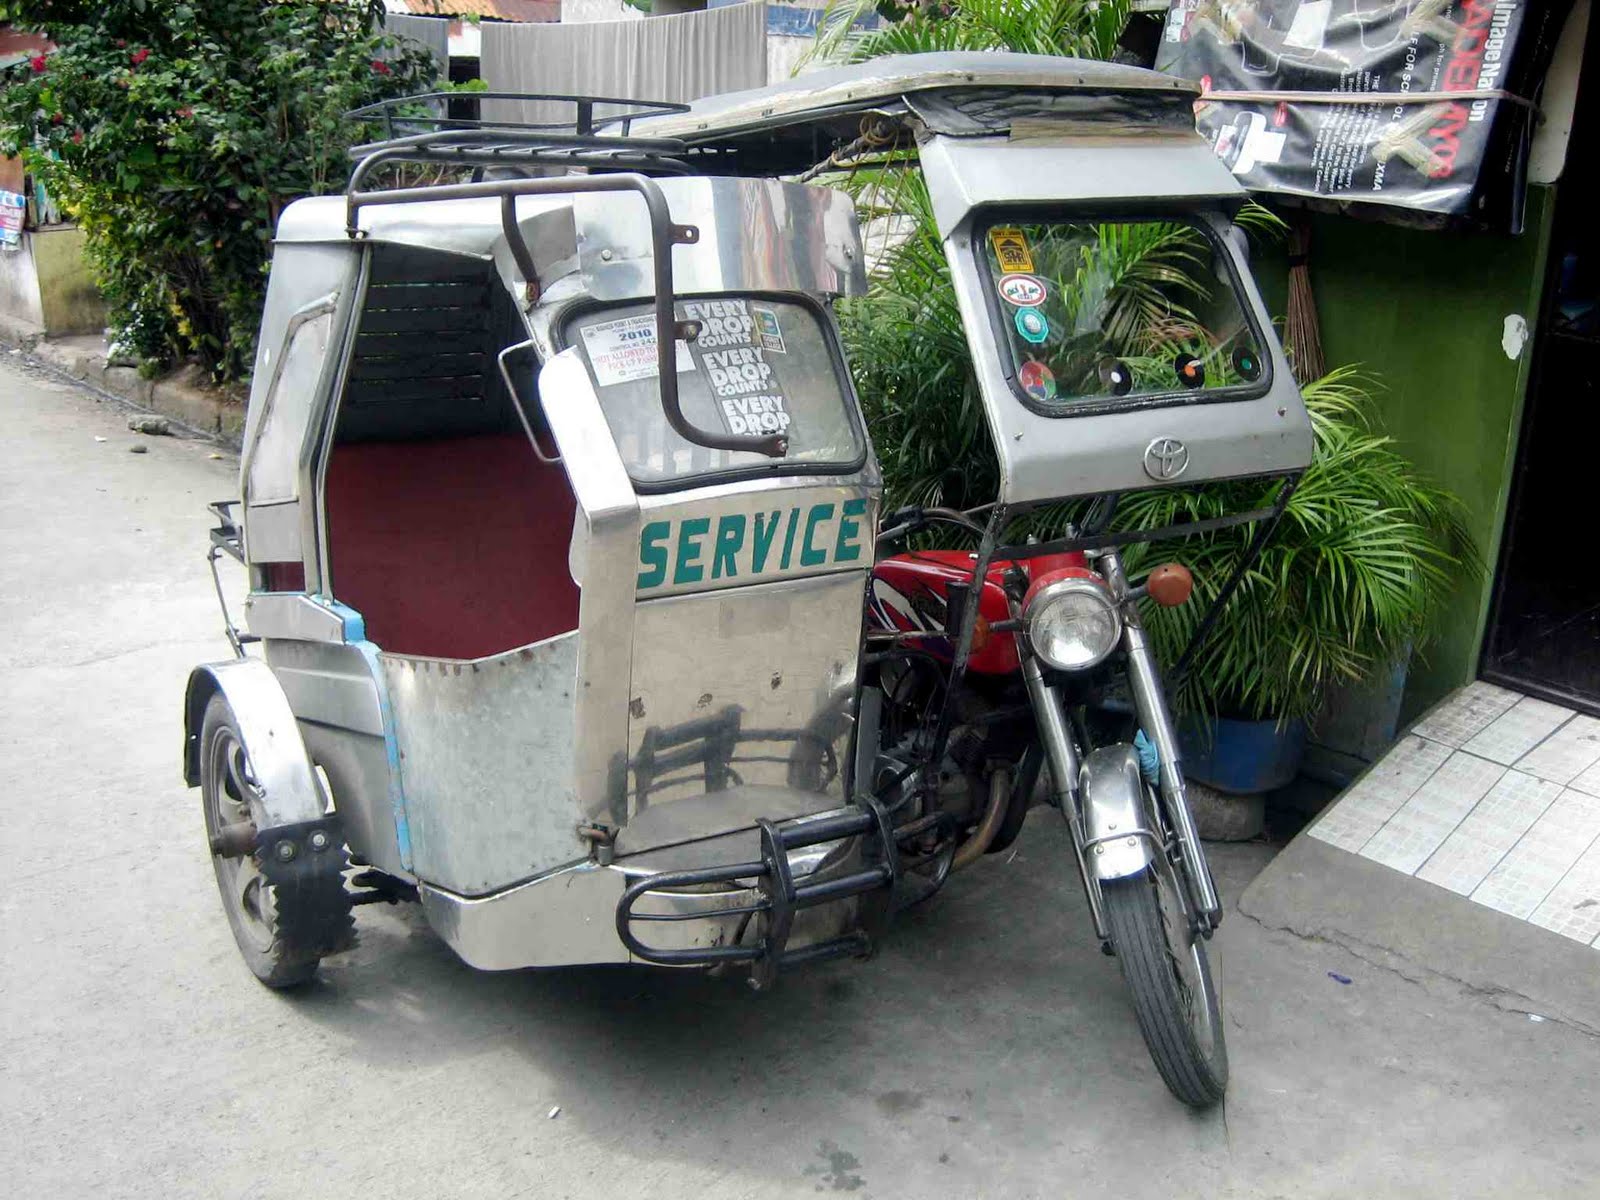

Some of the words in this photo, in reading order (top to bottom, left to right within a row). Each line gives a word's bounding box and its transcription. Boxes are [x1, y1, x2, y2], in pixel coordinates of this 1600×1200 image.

[683, 300, 749, 319] EVERY
[618, 327, 652, 341] 2010
[698, 332, 751, 348] COUNTS
[702, 347, 764, 370] EVERY
[709, 362, 772, 388] DROP
[716, 380, 769, 397] COUNTS
[721, 395, 785, 416] EVERY
[728, 412, 791, 435] DROP
[636, 500, 867, 590] SERVICE
